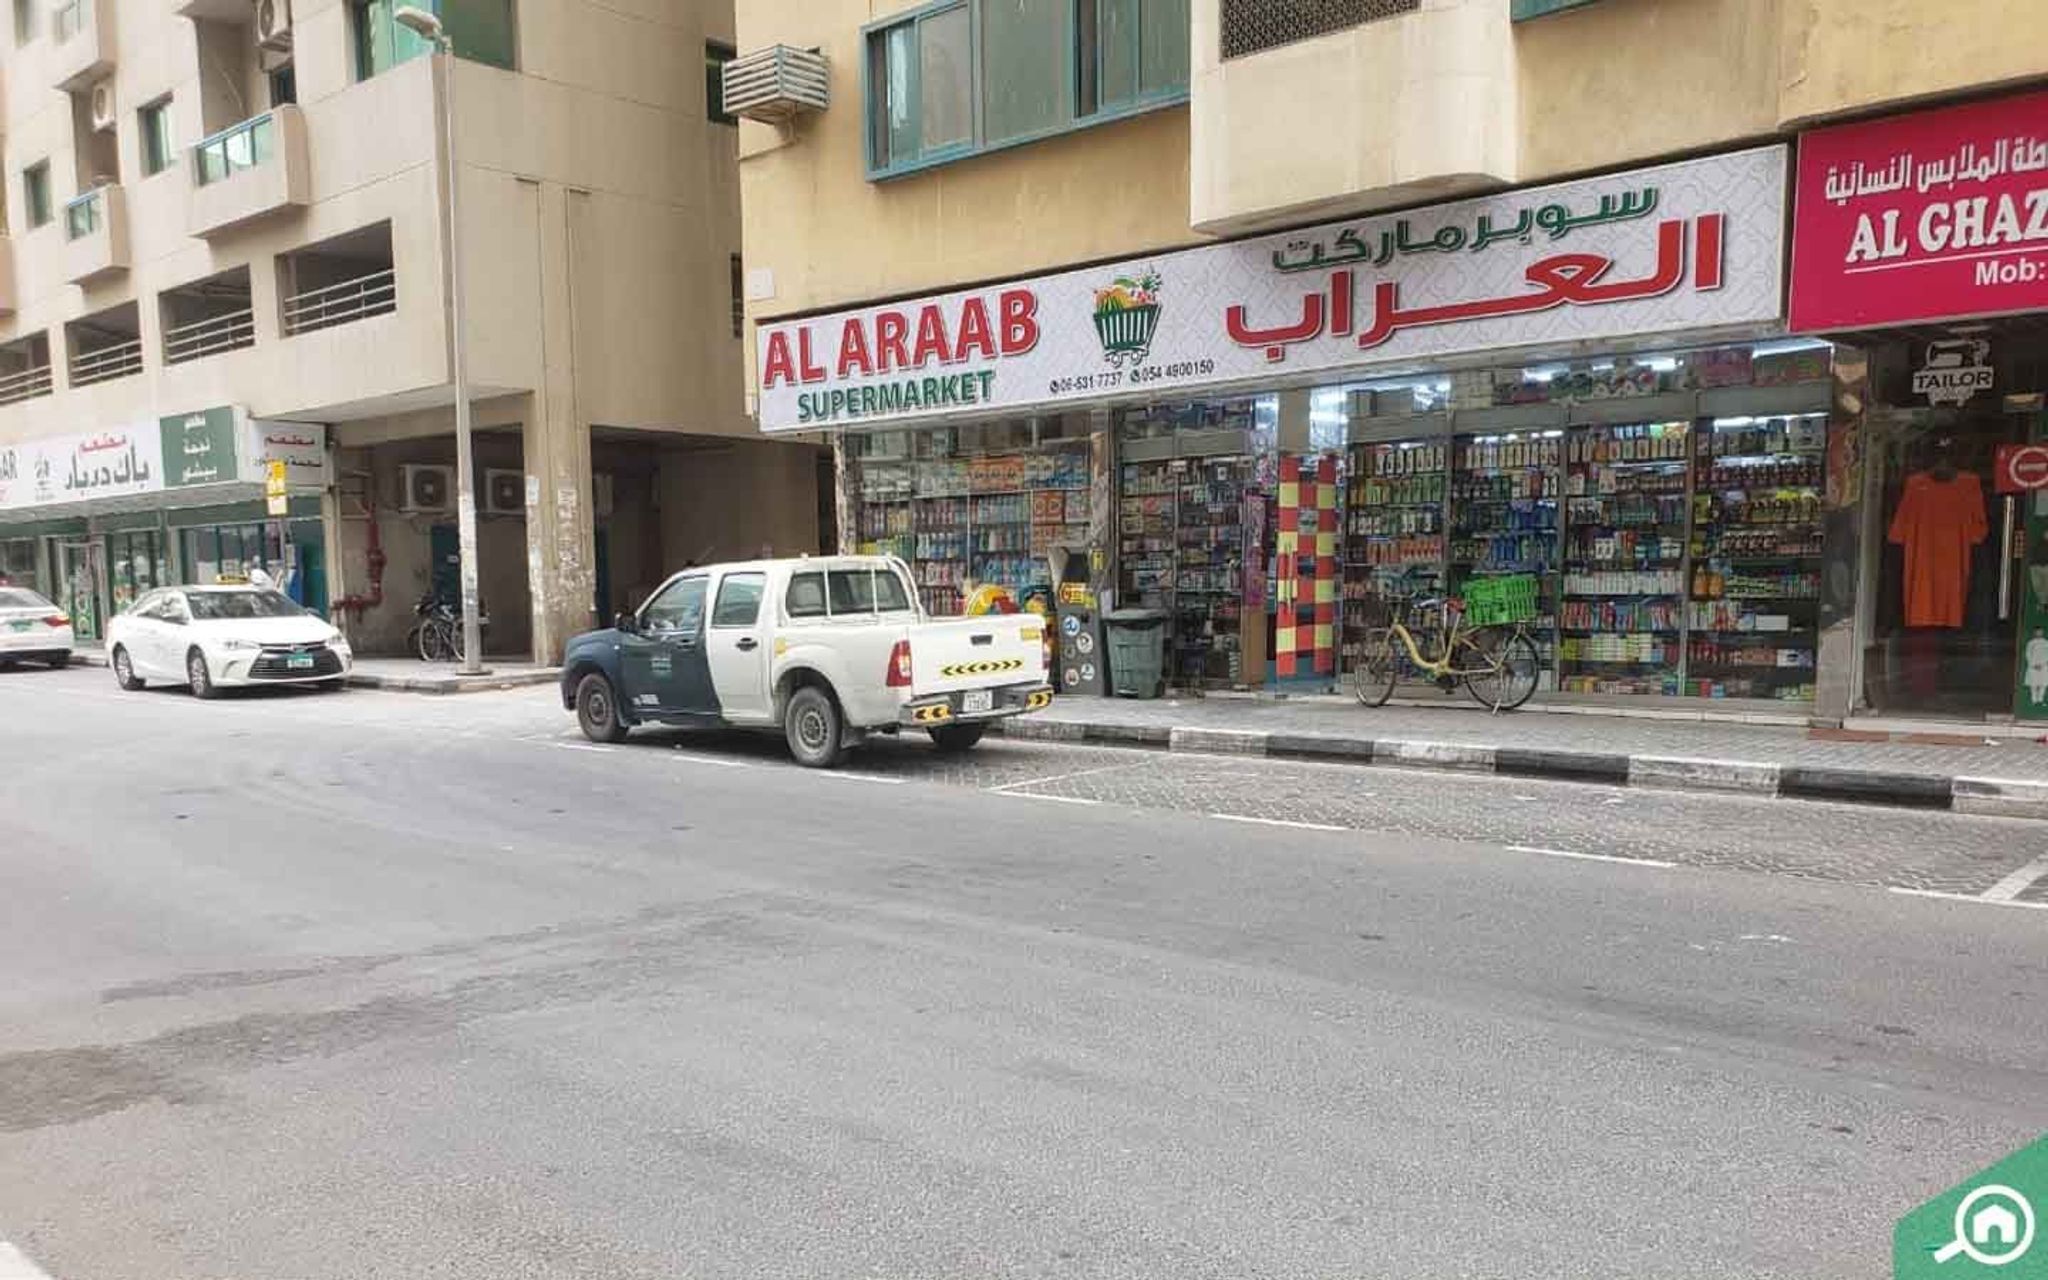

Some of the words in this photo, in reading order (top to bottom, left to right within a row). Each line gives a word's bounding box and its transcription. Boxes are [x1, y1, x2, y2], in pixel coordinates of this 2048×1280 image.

[1825, 153, 1912, 206] النسائية
[1918, 138, 2008, 193] الملابس
[1845, 208, 1908, 263] AL
[1226, 212, 1724, 363] العراب
[1975, 257, 2045, 287] Mob:
[762, 328, 826, 388] AL
[837, 288, 1040, 376] ARAAB
[798, 369, 997, 422] SUPERMARKET
[1914, 370, 1991, 390] TAILOR
